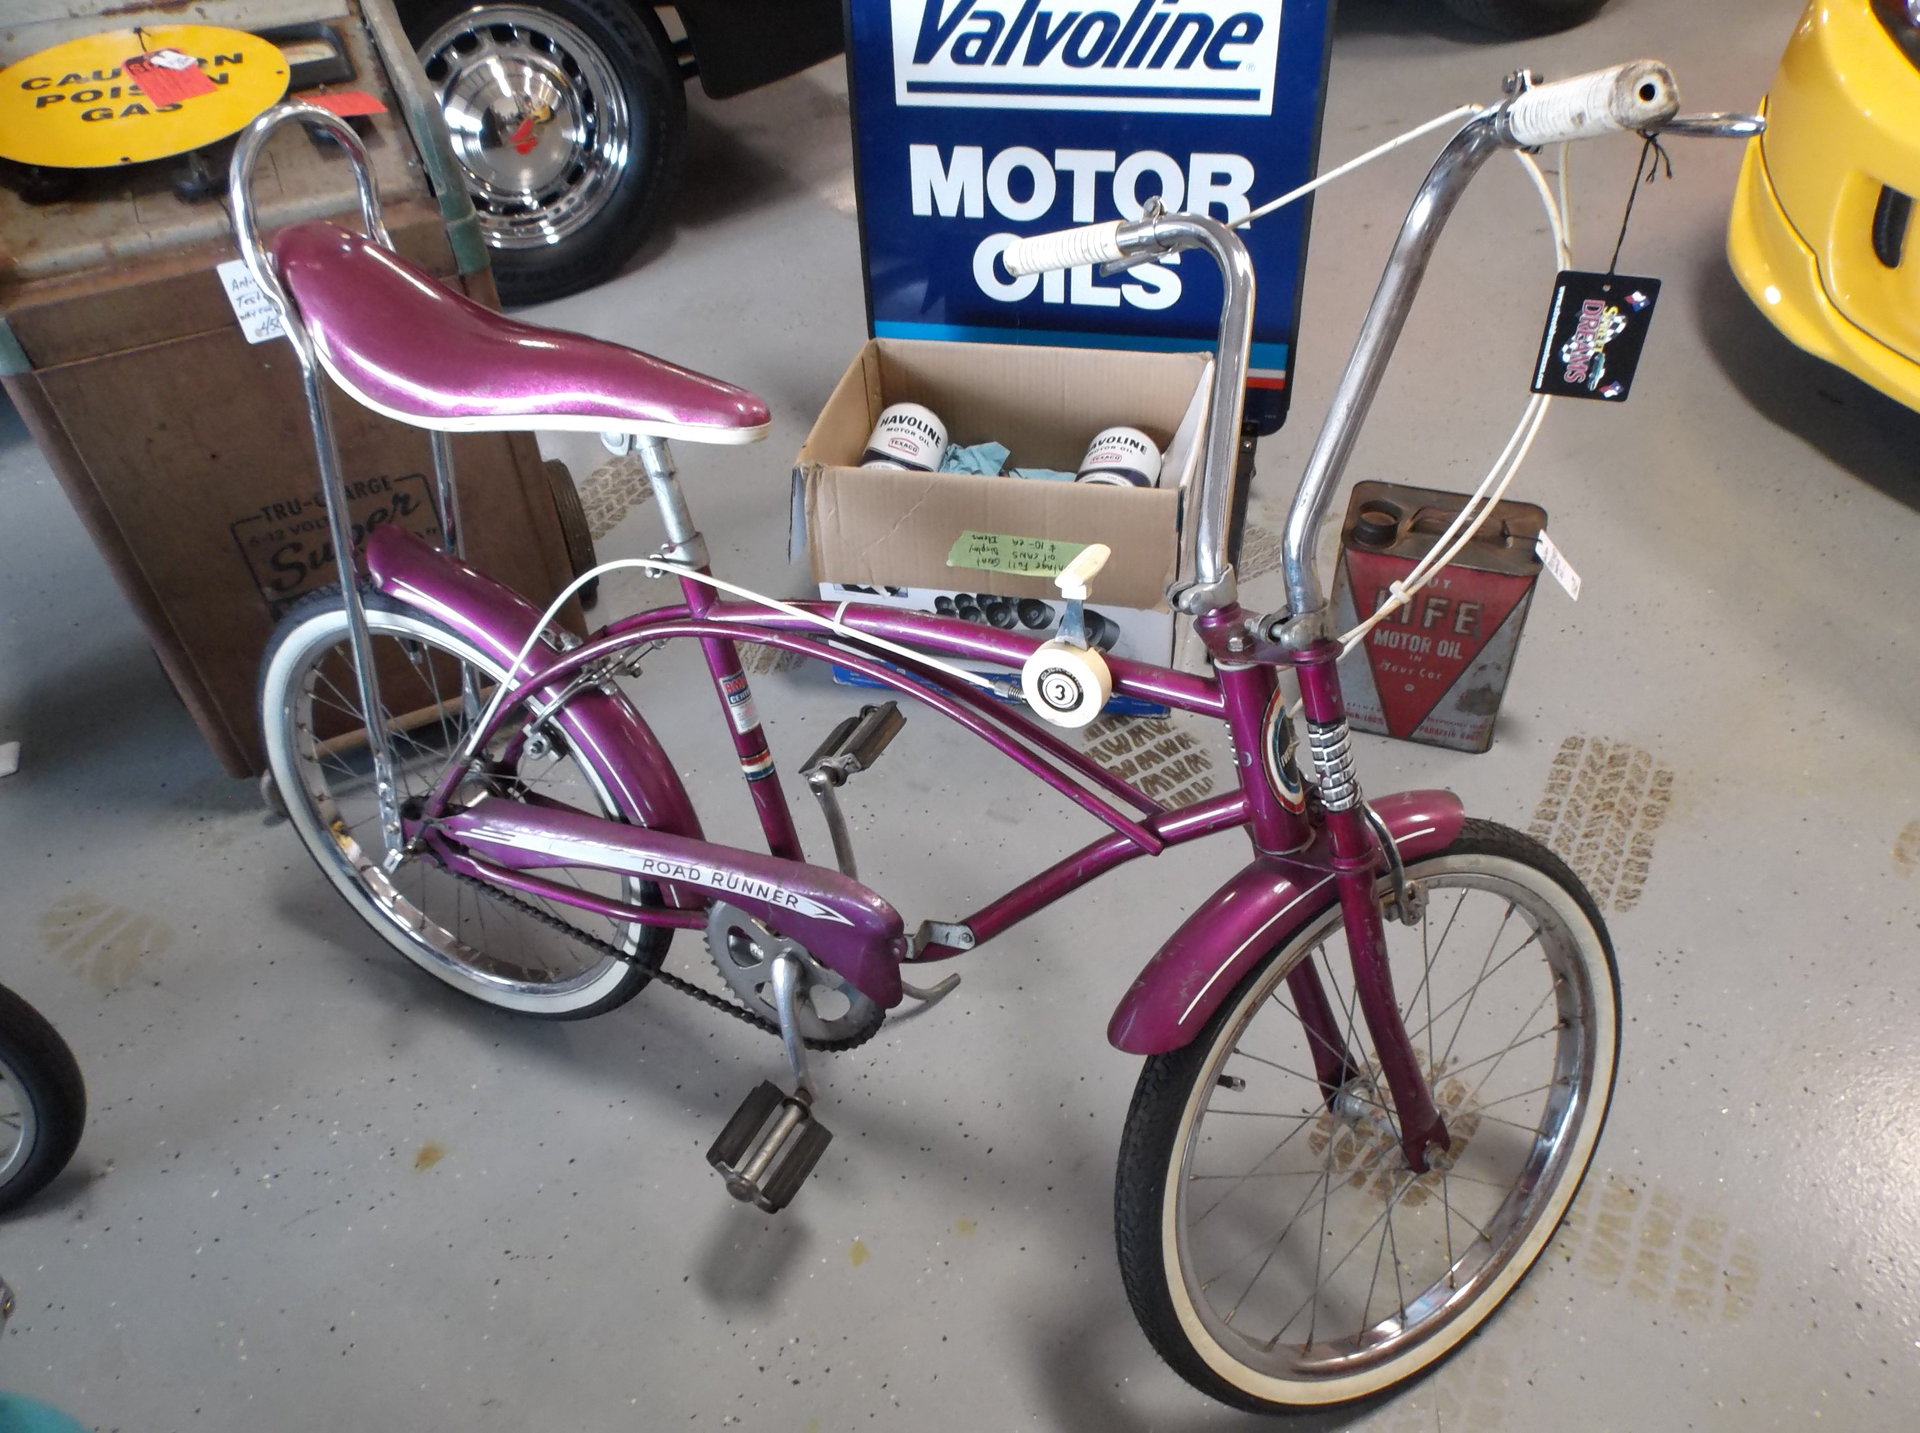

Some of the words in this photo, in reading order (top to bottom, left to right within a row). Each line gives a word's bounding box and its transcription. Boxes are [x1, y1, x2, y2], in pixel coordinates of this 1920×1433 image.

[912, 0, 1264, 70] Valvoline
[909, 144, 1255, 230] MOTOR
[1563, 299, 1605, 383] DREAMS
[880, 414, 942, 449] HAVOLINE
[886, 426, 916, 438] MOTOR
[918, 435, 931, 448] OIL
[890, 439, 918, 454] TEXACO
[1088, 435, 1148, 456] AVOLINE
[1119, 446, 1134, 455] OIL
[1373, 629, 1433, 653] MOTOR
[1436, 639, 1463, 660] OIL
[1419, 667, 1443, 680] Car
[1054, 684, 1066, 701] 3
[642, 858, 701, 881] ROAD
[711, 872, 799, 909] RUNNER
